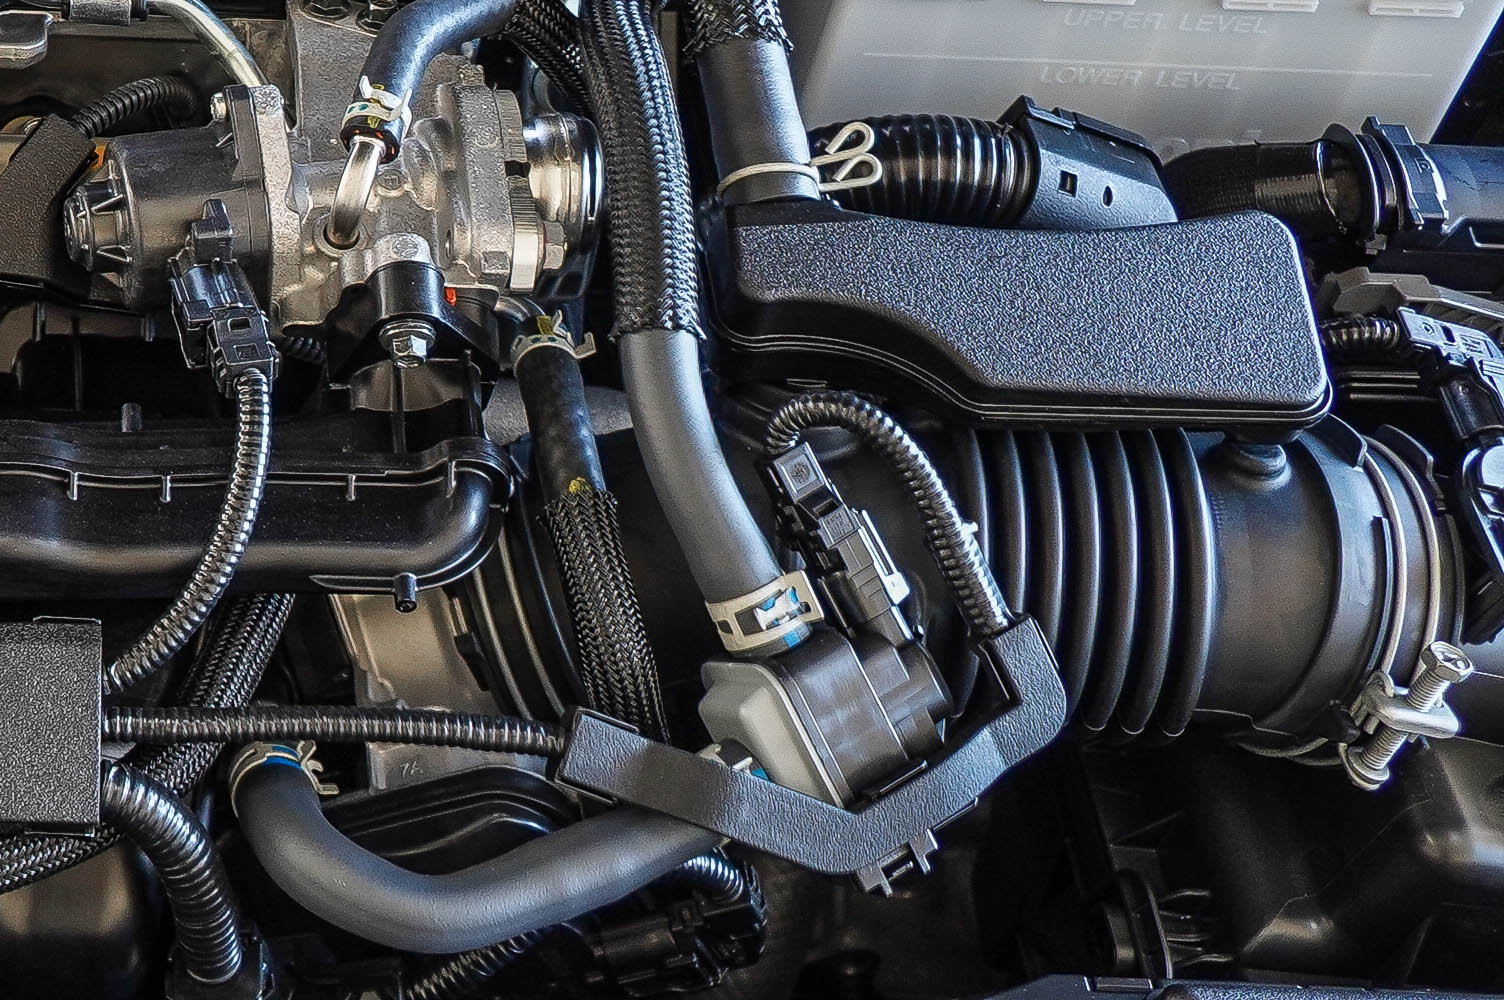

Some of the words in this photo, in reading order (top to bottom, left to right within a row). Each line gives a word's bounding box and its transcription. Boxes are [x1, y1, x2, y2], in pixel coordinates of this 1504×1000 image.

[1063, 8, 1164, 31] UPPER
[1178, 13, 1268, 35] LEVEL
[1041, 65, 1144, 88] LOWER
[1155, 70, 1241, 91] LEVEL
